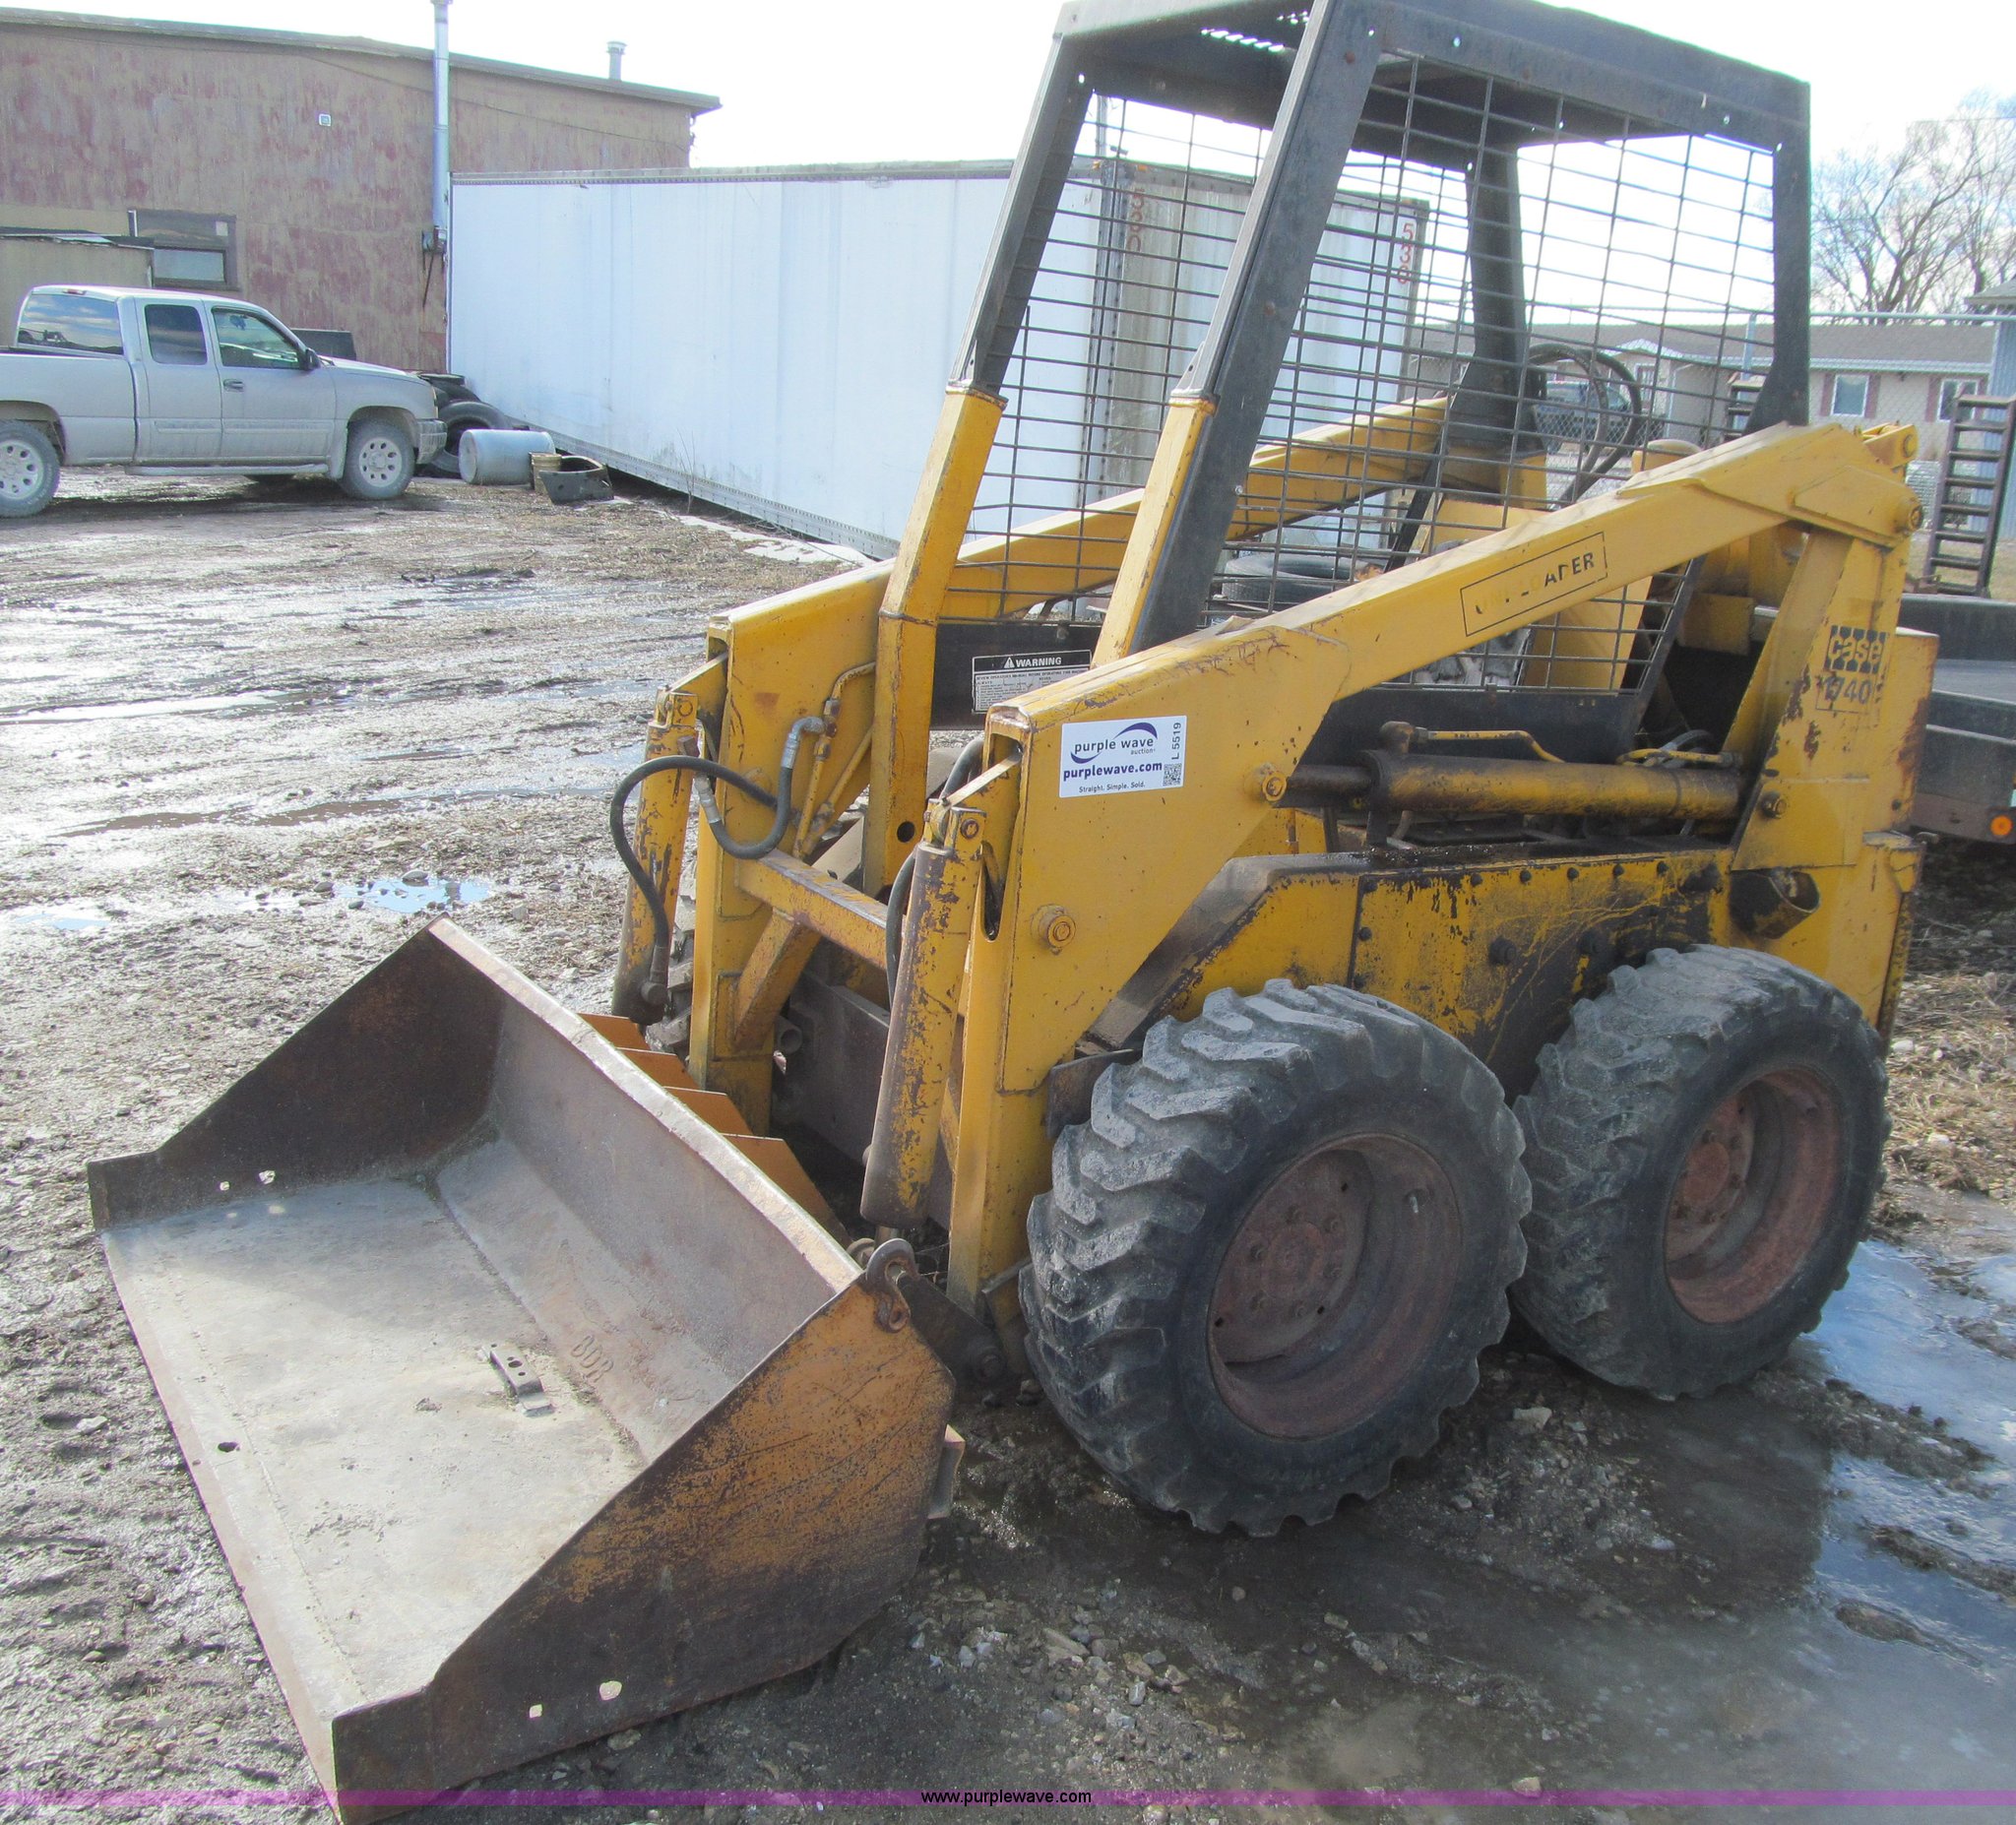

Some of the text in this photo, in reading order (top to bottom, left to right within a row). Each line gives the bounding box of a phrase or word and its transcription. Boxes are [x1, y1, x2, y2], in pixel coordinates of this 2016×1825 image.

[1015, 657, 1062, 667] WARNING
[1171, 722, 1181, 750] 5519
[1074, 737, 1154, 754] purple wave
[1063, 762, 1163, 782] purplewave.com
[1079, 785, 1104, 793] Straight.
[1106, 783, 1129, 791] Simple.
